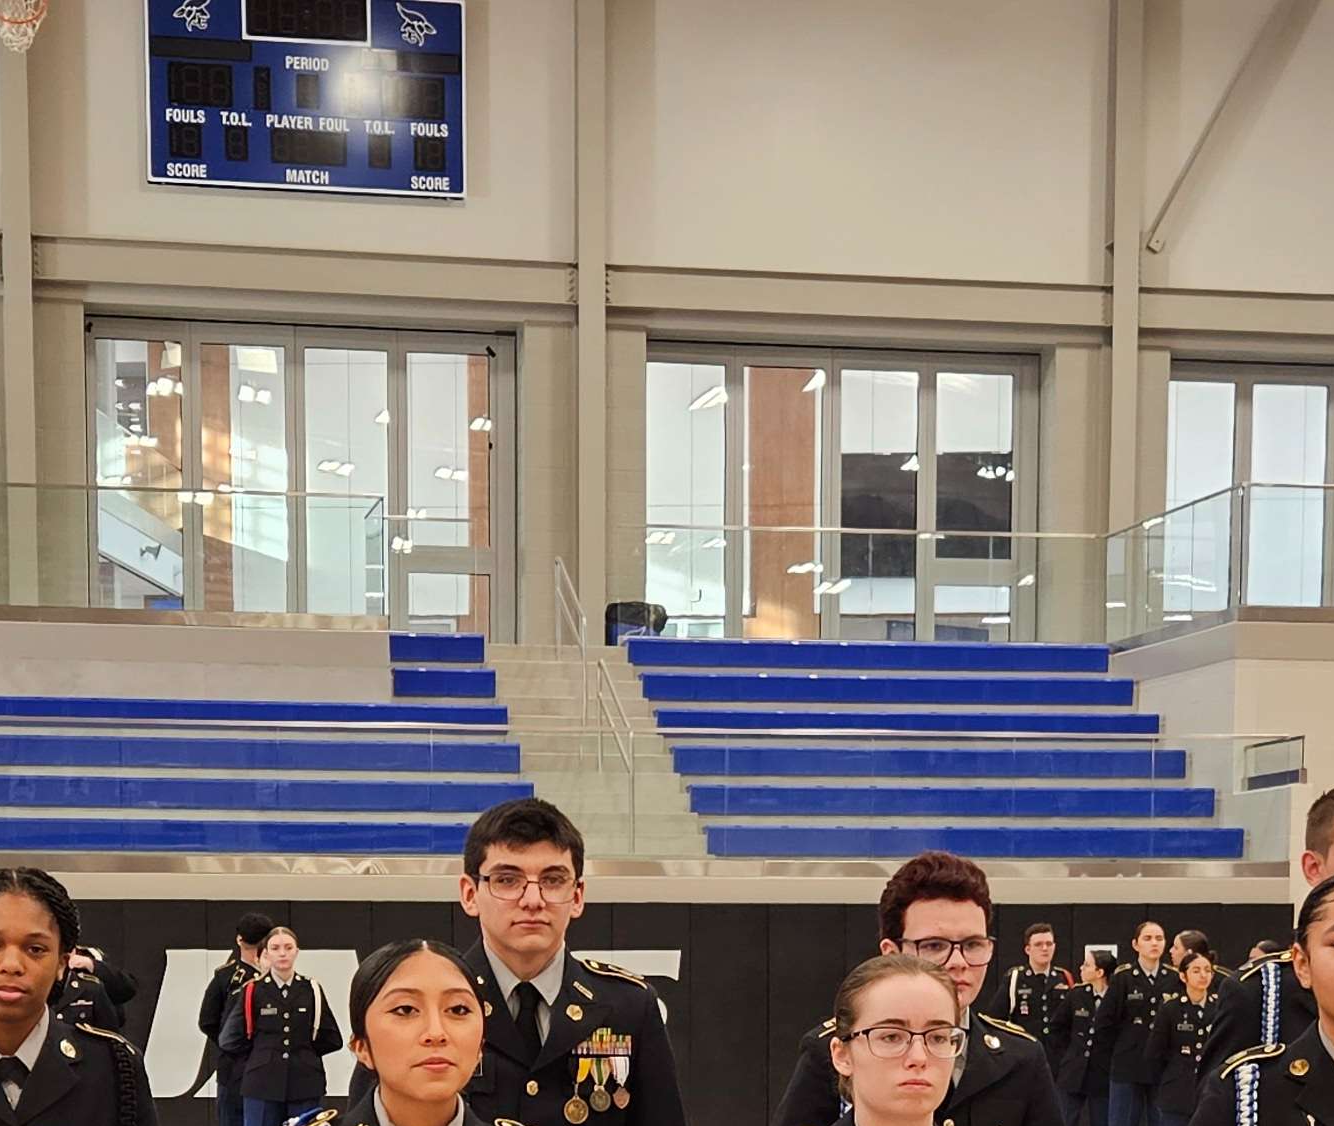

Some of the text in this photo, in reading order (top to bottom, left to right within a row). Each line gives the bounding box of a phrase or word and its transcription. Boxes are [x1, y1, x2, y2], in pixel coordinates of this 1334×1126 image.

[285, 55, 329, 72] PERIOD
[165, 108, 206, 124] FOULS
[221, 111, 252, 127] T.O.L.
[266, 114, 349, 133] PLAYER FOUL
[364, 119, 395, 136] T.O.L.
[410, 122, 449, 138] FOULS
[166, 163, 207, 179] SCORE
[285, 168, 329, 185] MATCH
[410, 176, 450, 192] SCORE
